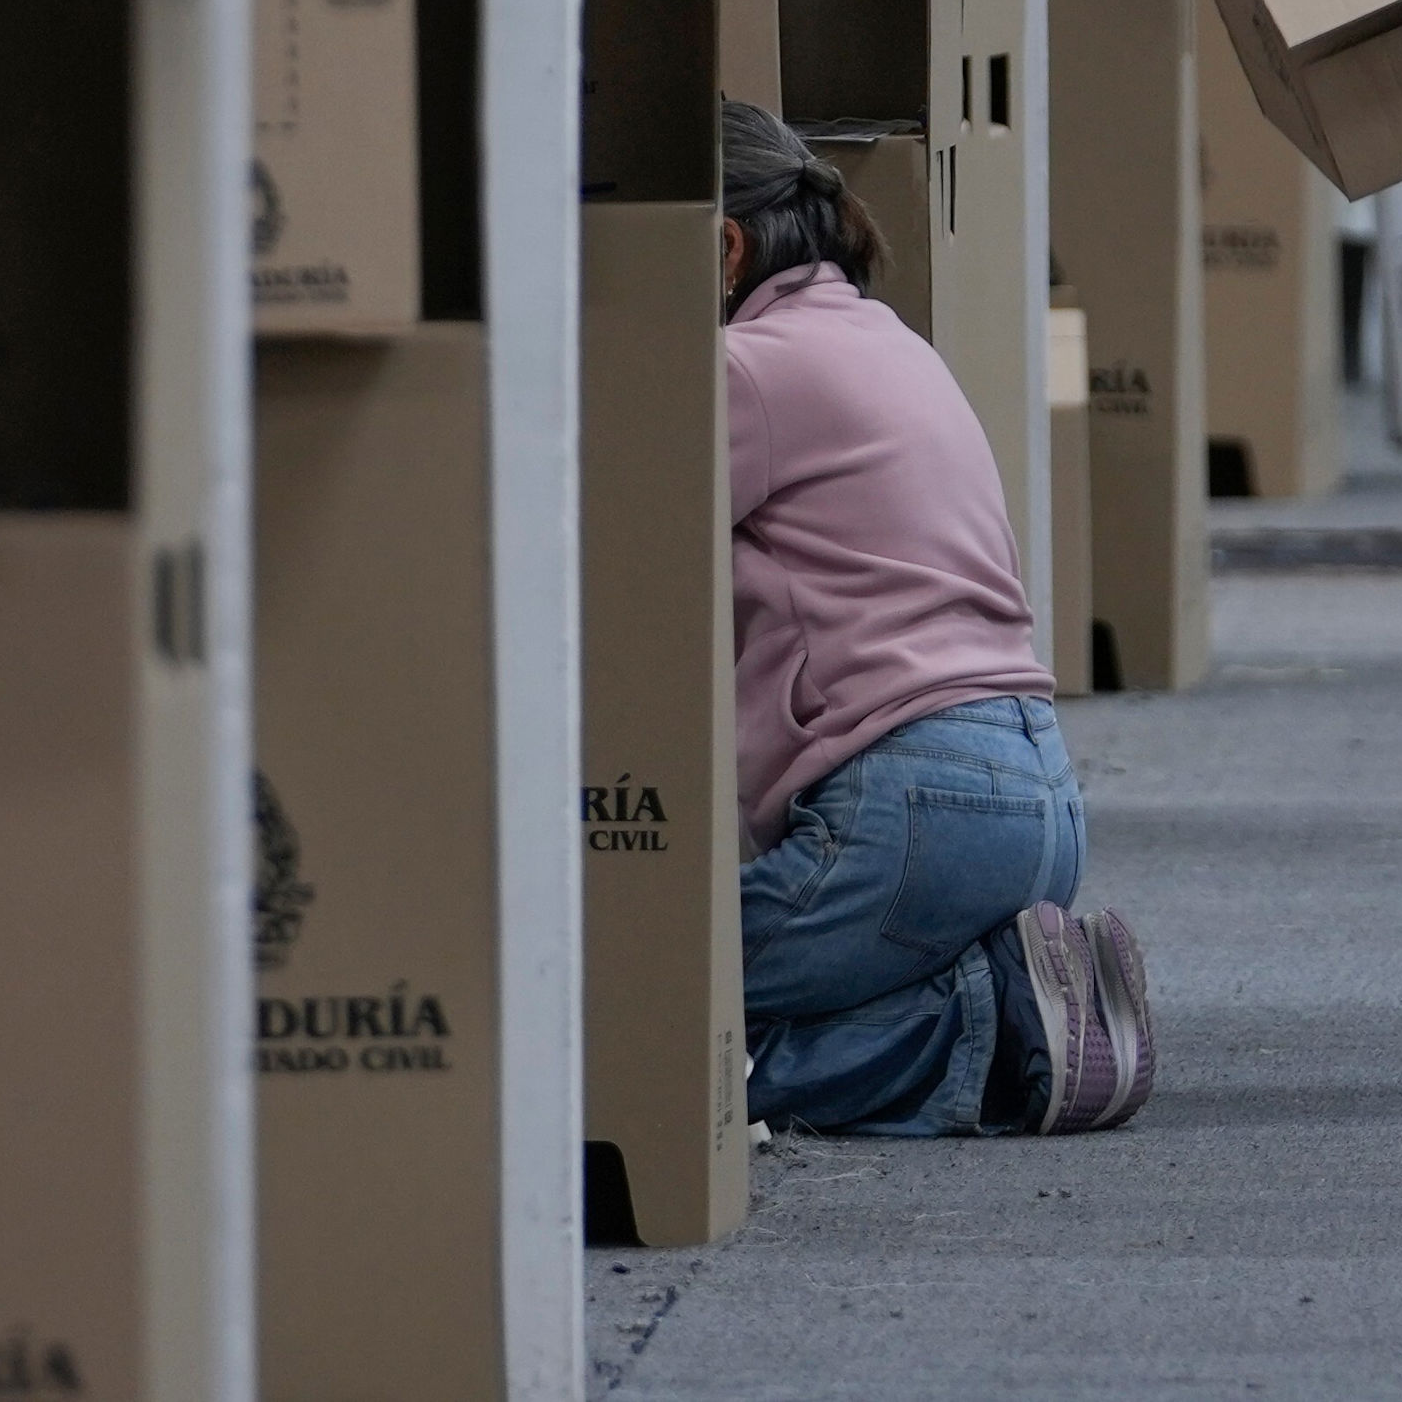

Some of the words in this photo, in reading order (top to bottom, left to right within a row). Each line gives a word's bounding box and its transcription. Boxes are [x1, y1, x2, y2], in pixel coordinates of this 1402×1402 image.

[581, 772, 668, 822] RÍA
[589, 829, 669, 851] CIVIL
[257, 978, 451, 1038] DURÍA
[359, 1047, 453, 1071] CIVIL
